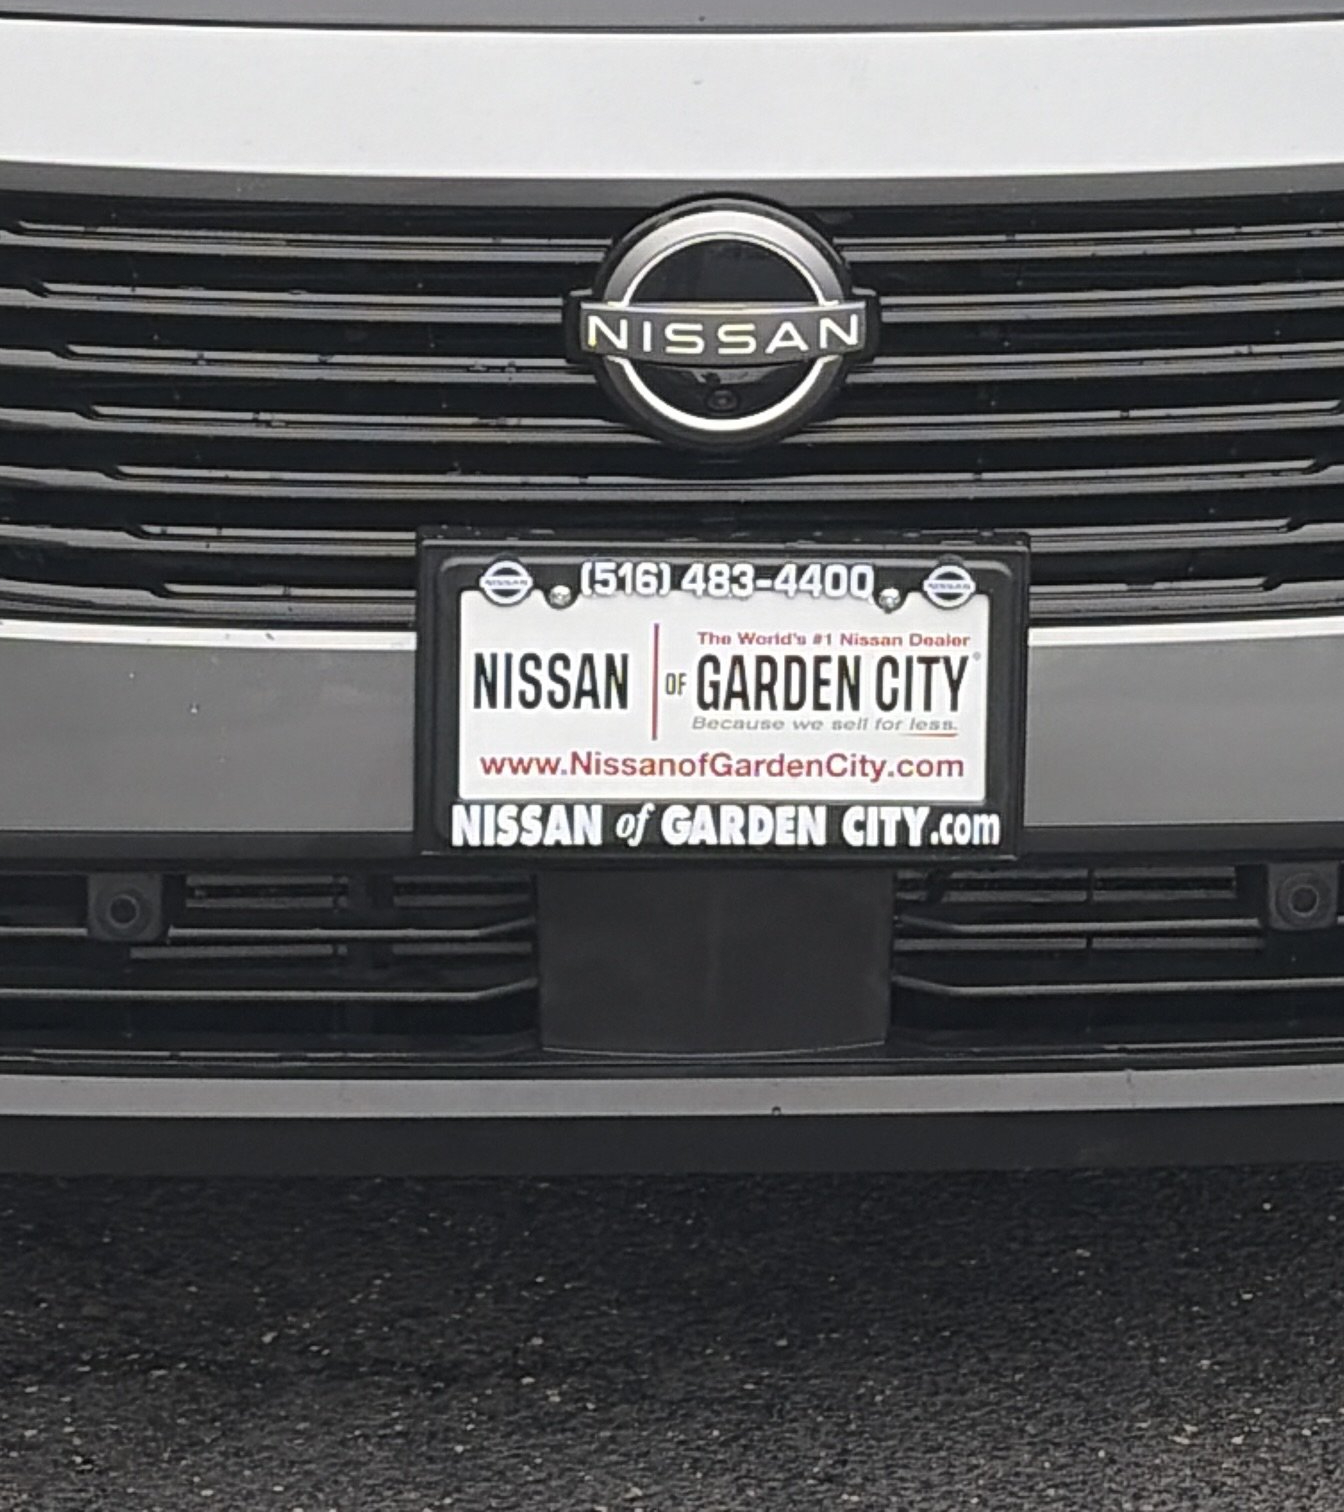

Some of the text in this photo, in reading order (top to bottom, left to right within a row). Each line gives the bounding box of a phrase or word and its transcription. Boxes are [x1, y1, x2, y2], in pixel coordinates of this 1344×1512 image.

[587, 313, 859, 355] NISSAN
[580, 560, 875, 600] (516) 483-4400
[697, 631, 971, 647] The World's #1 Nissan Dealer
[472, 652, 970, 713] NISSAN OF GARDEN CITY
[691, 716, 959, 732] Because we sell for less.
[480, 750, 965, 782] www.NissanofGardenCity.com
[452, 803, 1000, 847] NISSAN of GARDEN CITY.com
